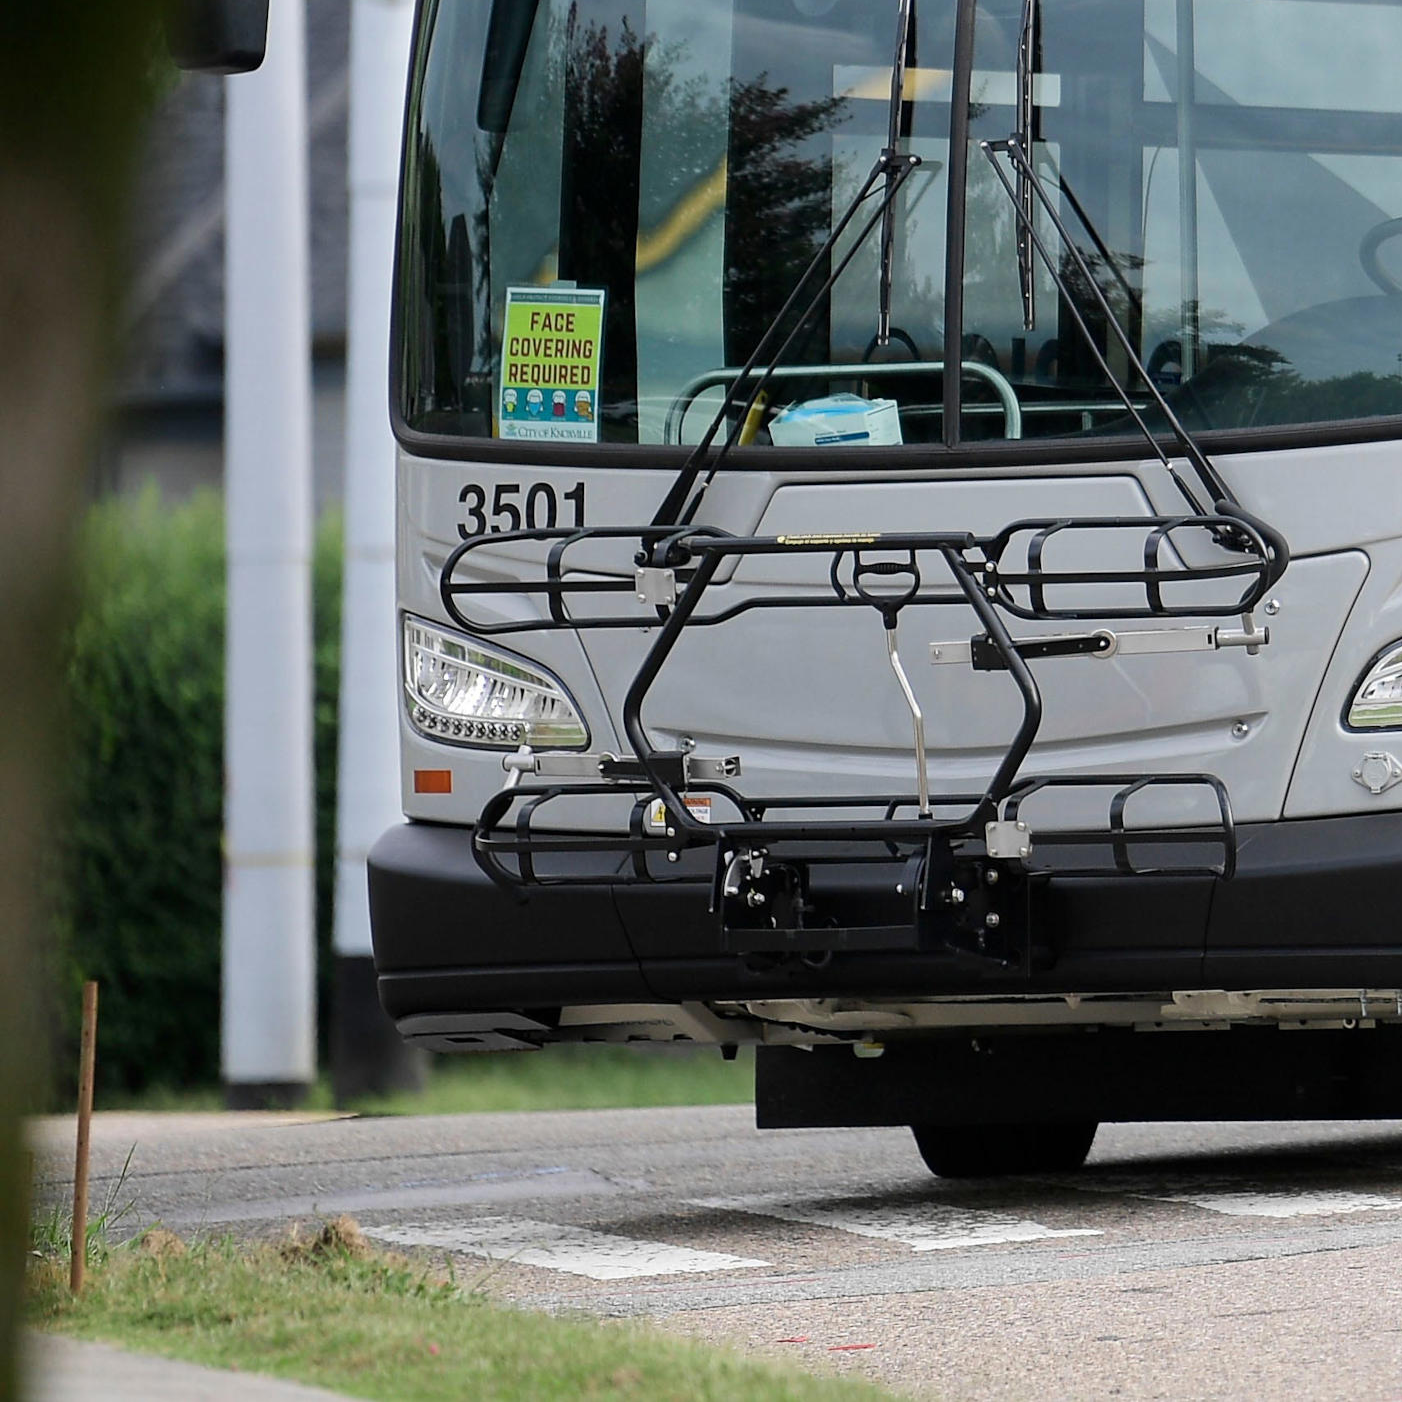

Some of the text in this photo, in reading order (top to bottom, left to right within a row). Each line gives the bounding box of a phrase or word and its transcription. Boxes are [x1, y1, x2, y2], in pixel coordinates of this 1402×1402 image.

[530, 312, 576, 333] FACE
[509, 337, 593, 359] COVERING
[508, 363, 591, 386] REQUIRED
[457, 482, 585, 541] 3501
